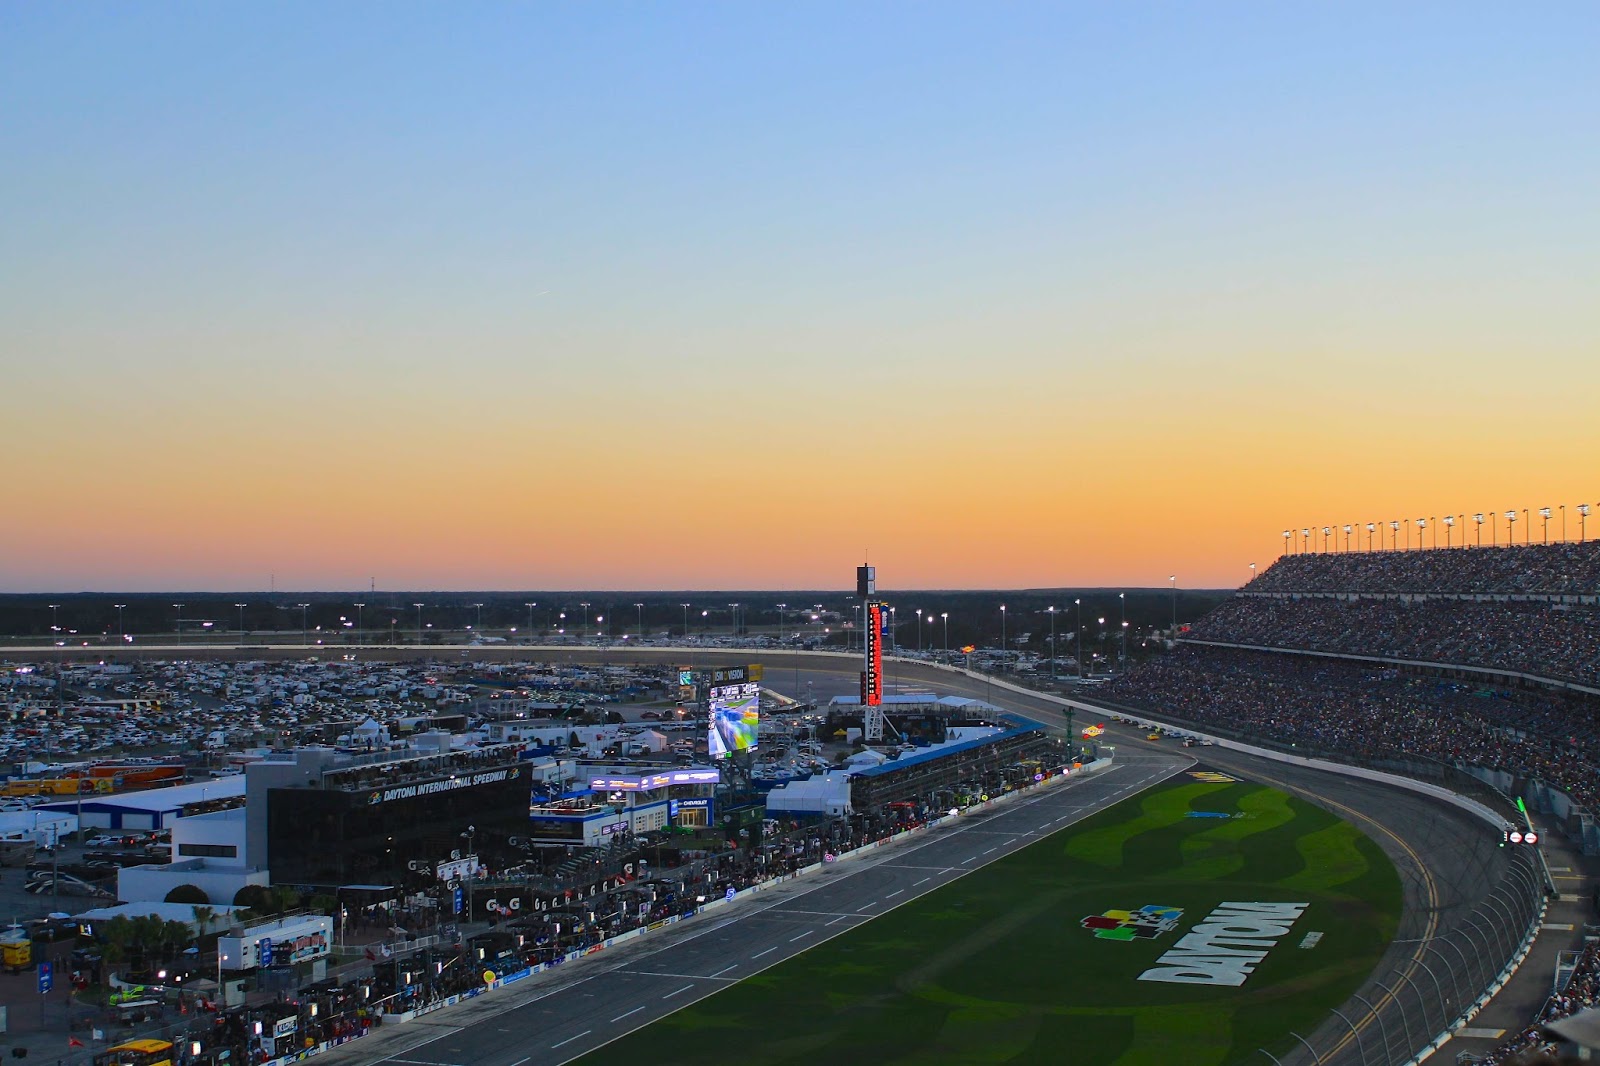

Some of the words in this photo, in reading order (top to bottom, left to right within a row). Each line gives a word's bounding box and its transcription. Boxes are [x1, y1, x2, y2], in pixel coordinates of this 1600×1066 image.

[728, 669, 744, 680] VISION
[383, 786, 416, 802] DAYTONA
[417, 778, 472, 795] INTERNATIONAL
[472, 770, 508, 786] SPEEDWAY
[408, 860, 417, 871] G
[624, 863, 633, 876] G
[590, 884, 596, 896] G
[603, 881, 608, 892] G
[486, 898, 497, 912] G
[509, 897, 520, 910] G
[535, 898, 540, 911] G
[542, 900, 548, 912] G
[552, 896, 558, 908] G
[1136, 902, 1310, 986] DAYTONA
